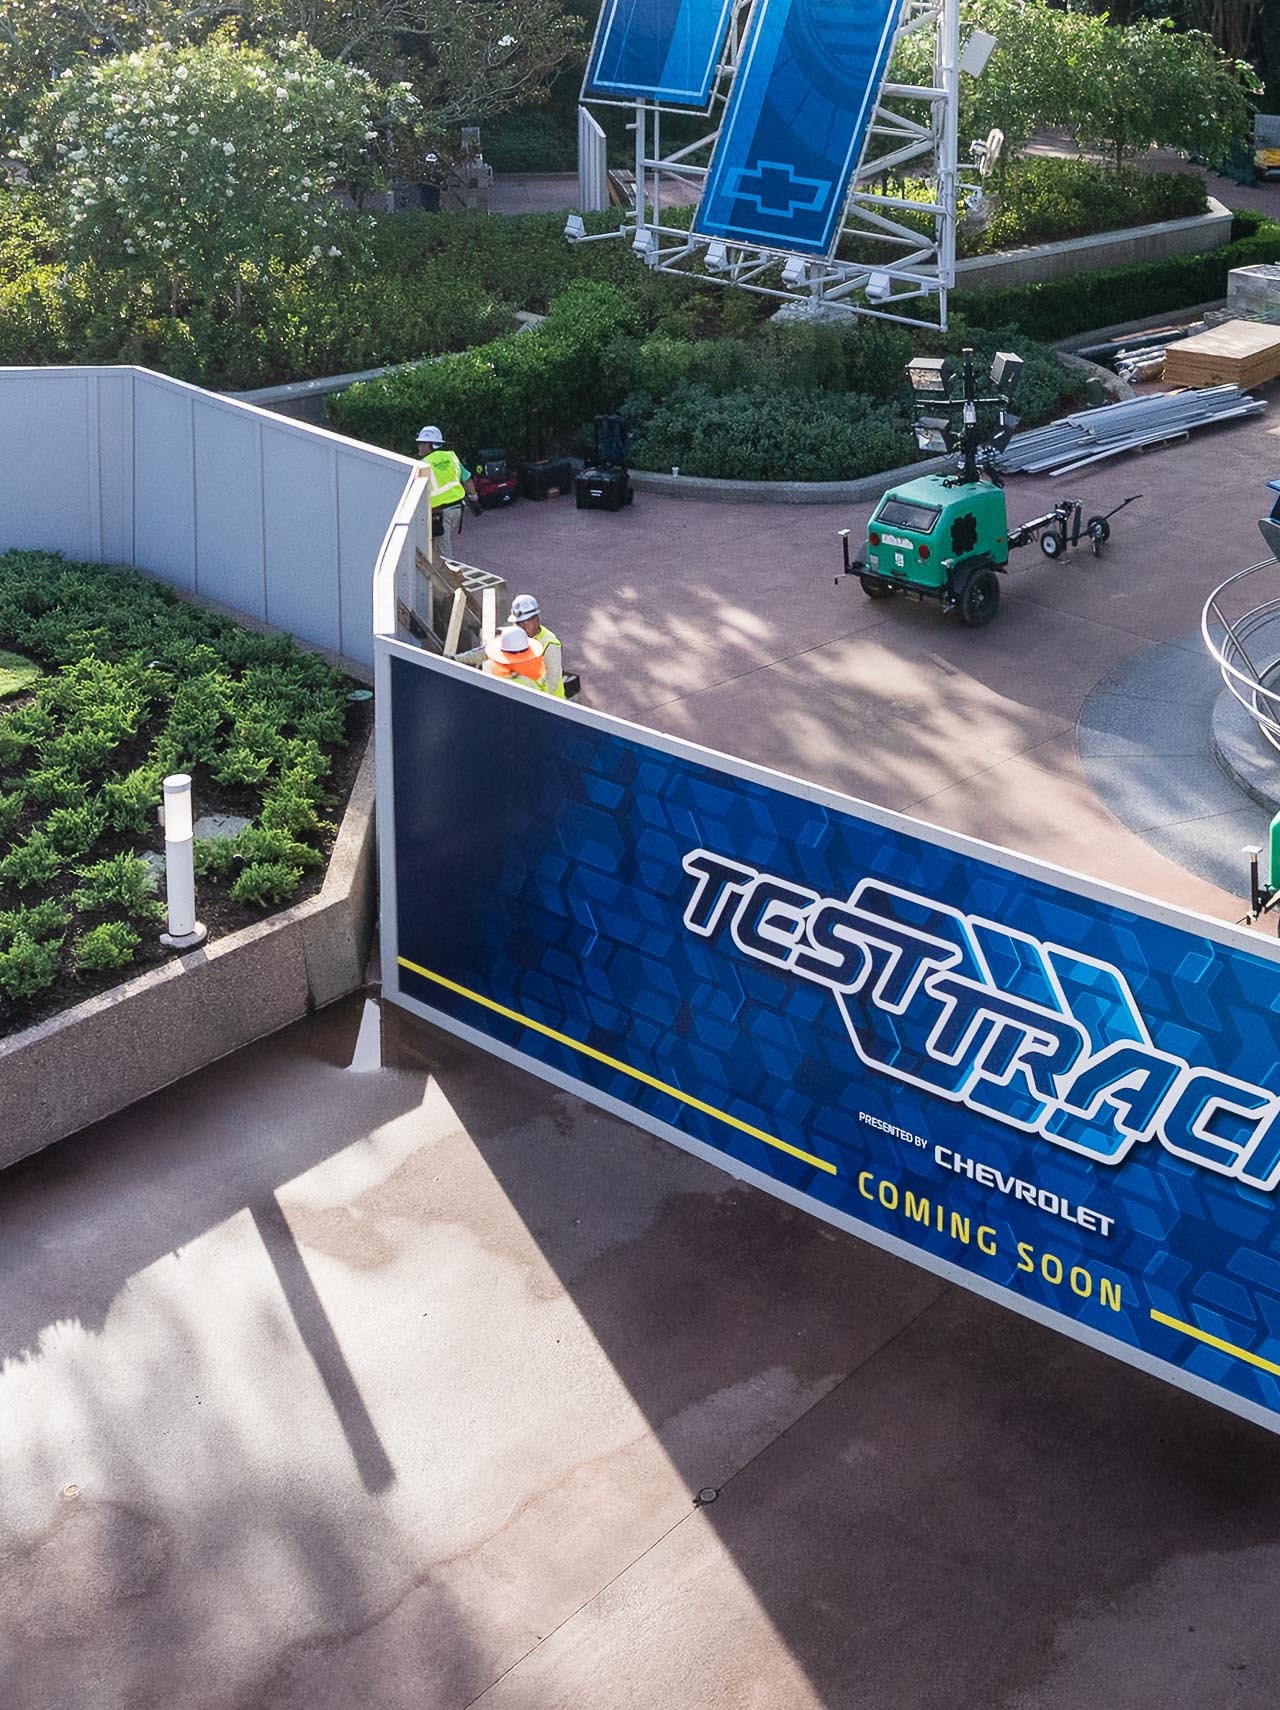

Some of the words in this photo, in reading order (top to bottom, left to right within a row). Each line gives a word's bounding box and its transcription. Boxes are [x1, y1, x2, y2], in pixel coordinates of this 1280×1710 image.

[682, 848, 963, 1016] TEST
[858, 1111, 913, 1144] PRESENTED
[914, 1137, 928, 1149] BY
[858, 1171, 997, 1256] COMING
[1016, 1241, 1122, 1313] SOON
[934, 1144, 1115, 1237] CHEVROLET
